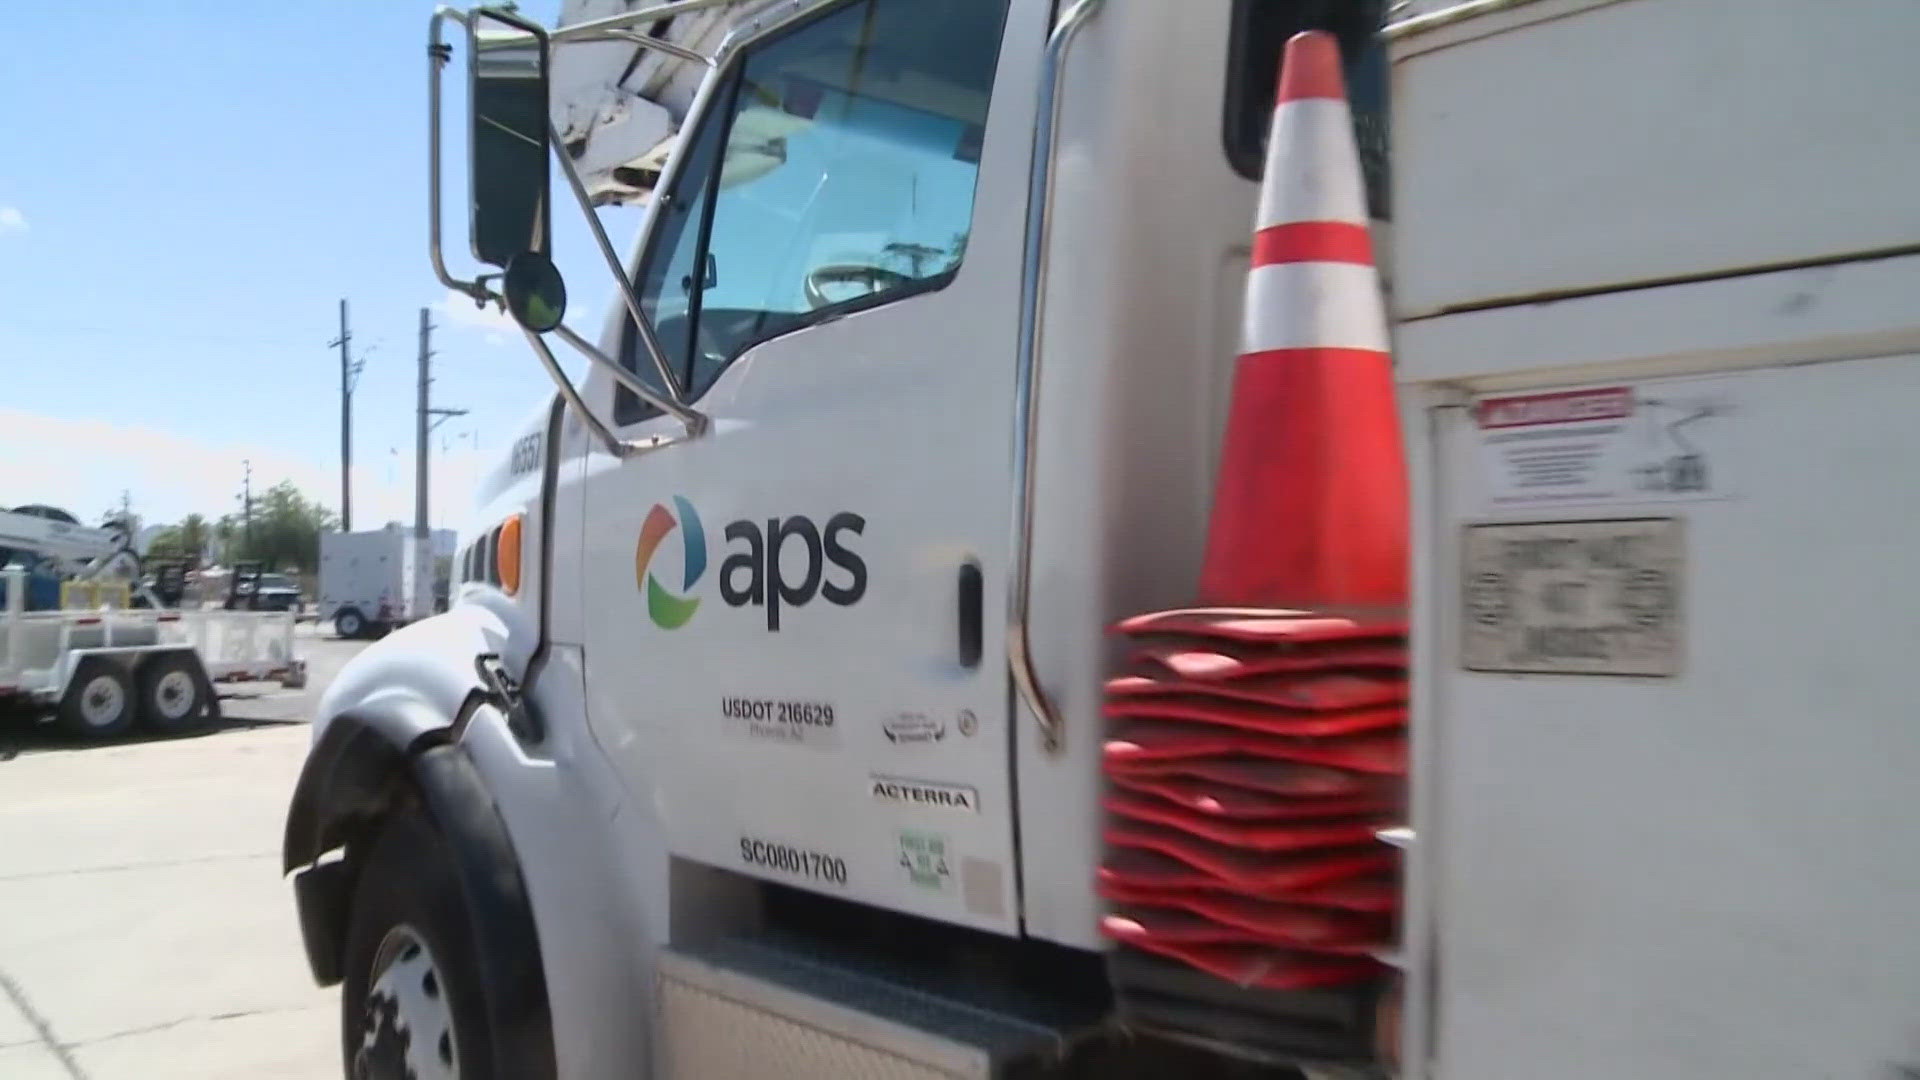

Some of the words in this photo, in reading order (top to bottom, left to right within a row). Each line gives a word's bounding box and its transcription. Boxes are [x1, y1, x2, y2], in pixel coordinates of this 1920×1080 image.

[720, 511, 867, 631] aps
[722, 696, 773, 722] USDOT
[778, 701, 834, 727] 216629
[874, 783, 969, 808] ACTERRA
[741, 837, 847, 884] SC0801700
